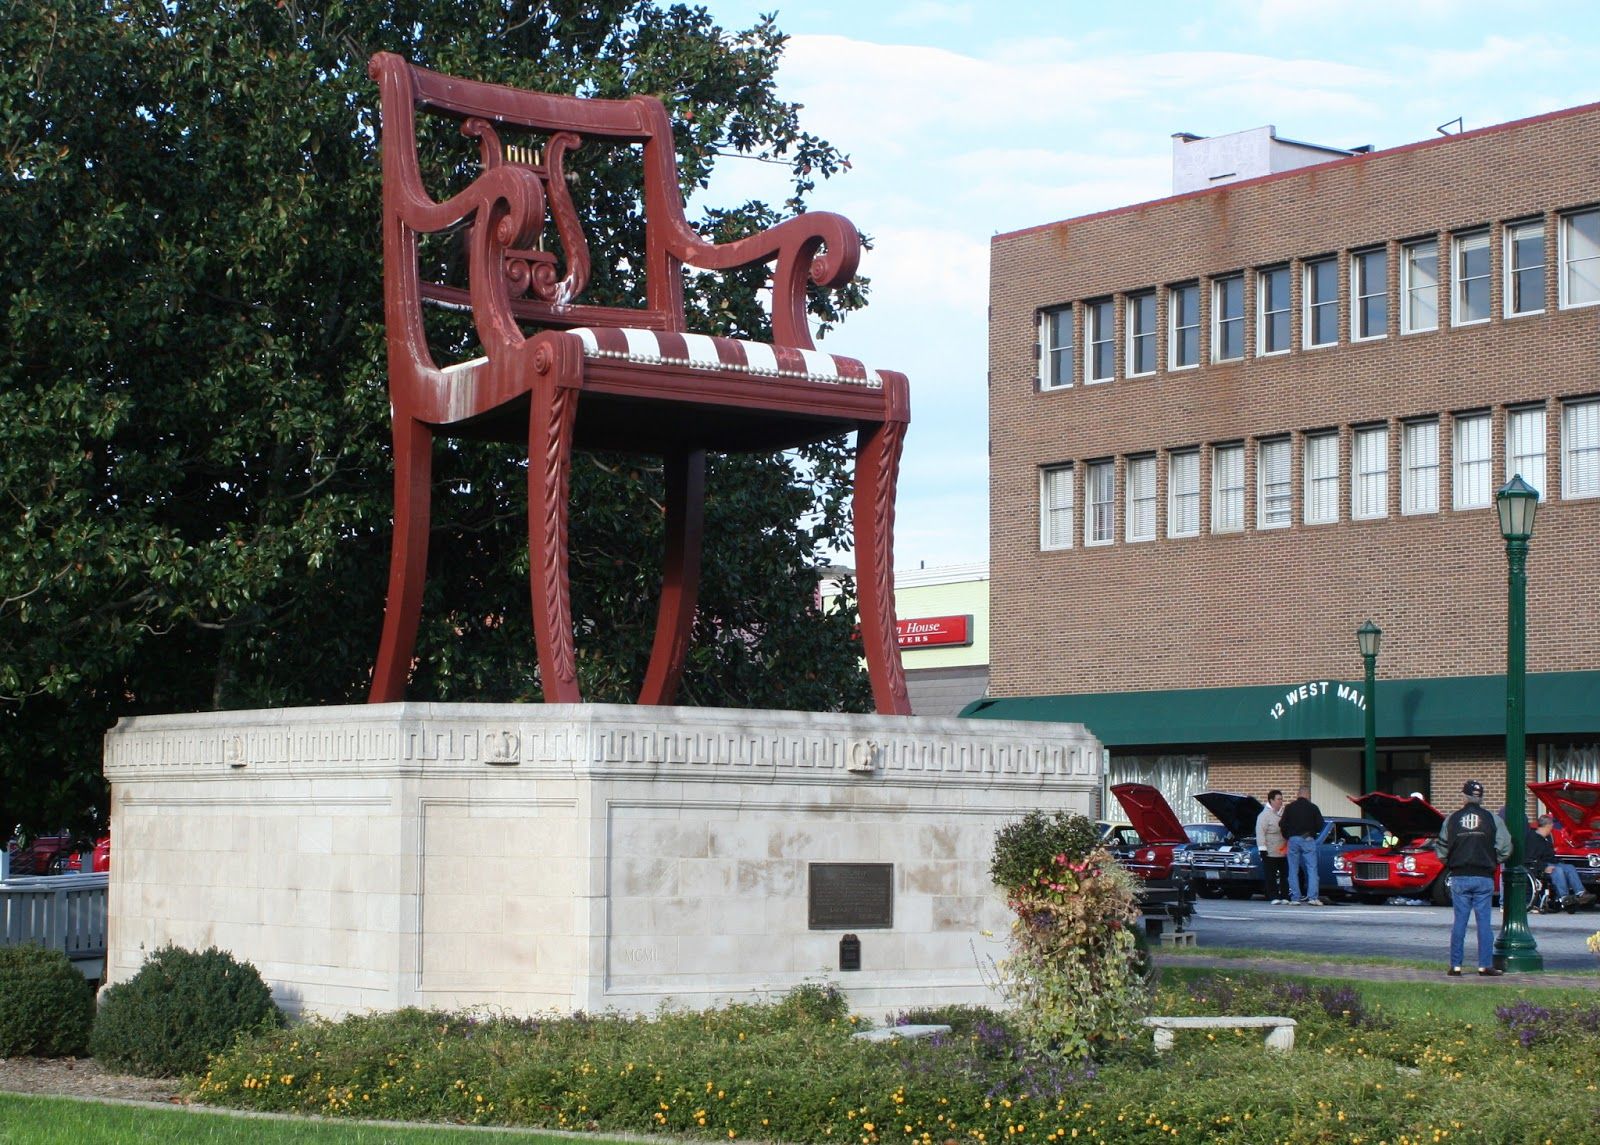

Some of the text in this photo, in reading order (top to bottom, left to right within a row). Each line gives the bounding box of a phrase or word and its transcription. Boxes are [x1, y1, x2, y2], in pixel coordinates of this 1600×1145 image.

[906, 622, 940, 633] House
[1270, 702, 1285, 719] 12
[1286, 682, 1329, 705] WEST
